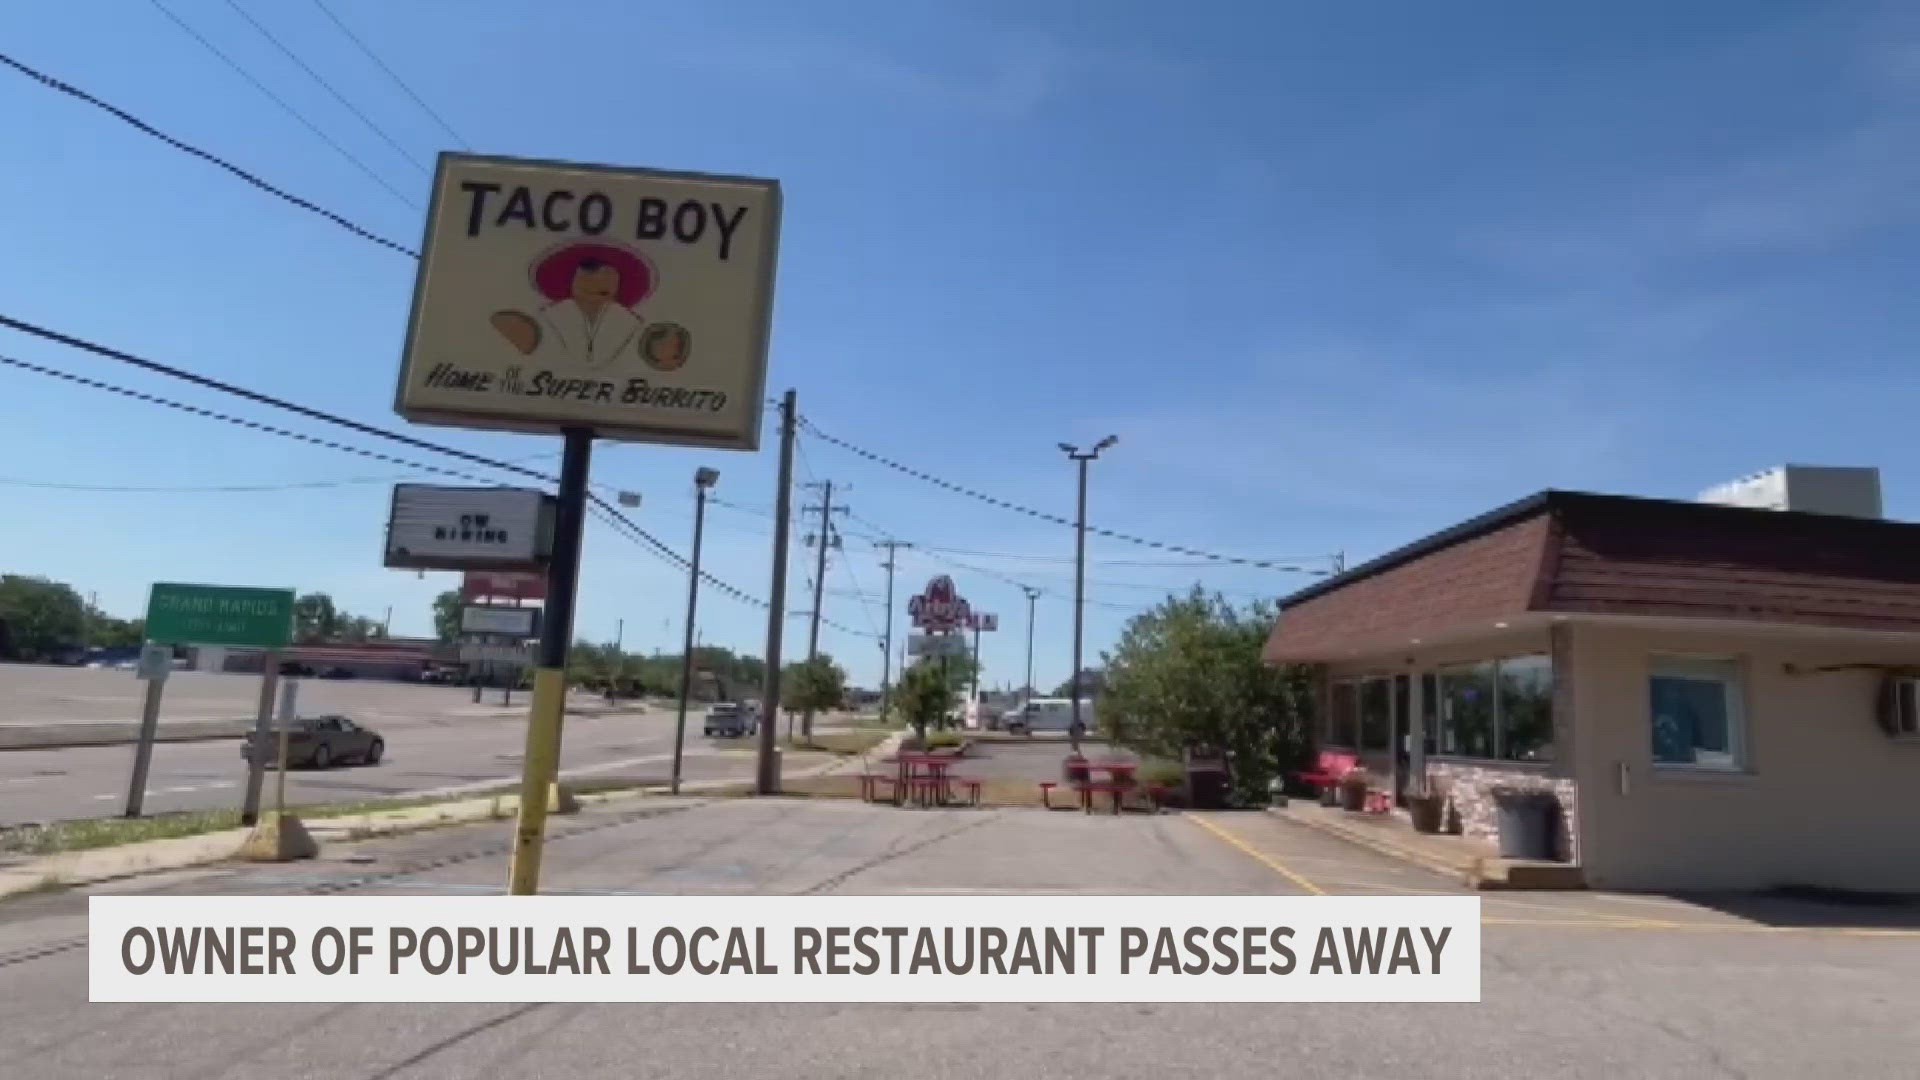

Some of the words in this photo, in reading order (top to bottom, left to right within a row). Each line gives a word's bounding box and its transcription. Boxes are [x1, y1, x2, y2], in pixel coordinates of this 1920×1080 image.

[461, 182, 613, 239] TACO
[635, 196, 748, 261] BOY
[424, 363, 494, 392] HOME
[526, 370, 615, 402] SUPER
[620, 378, 728, 412] BURRITO
[159, 594, 214, 613] GRAND
